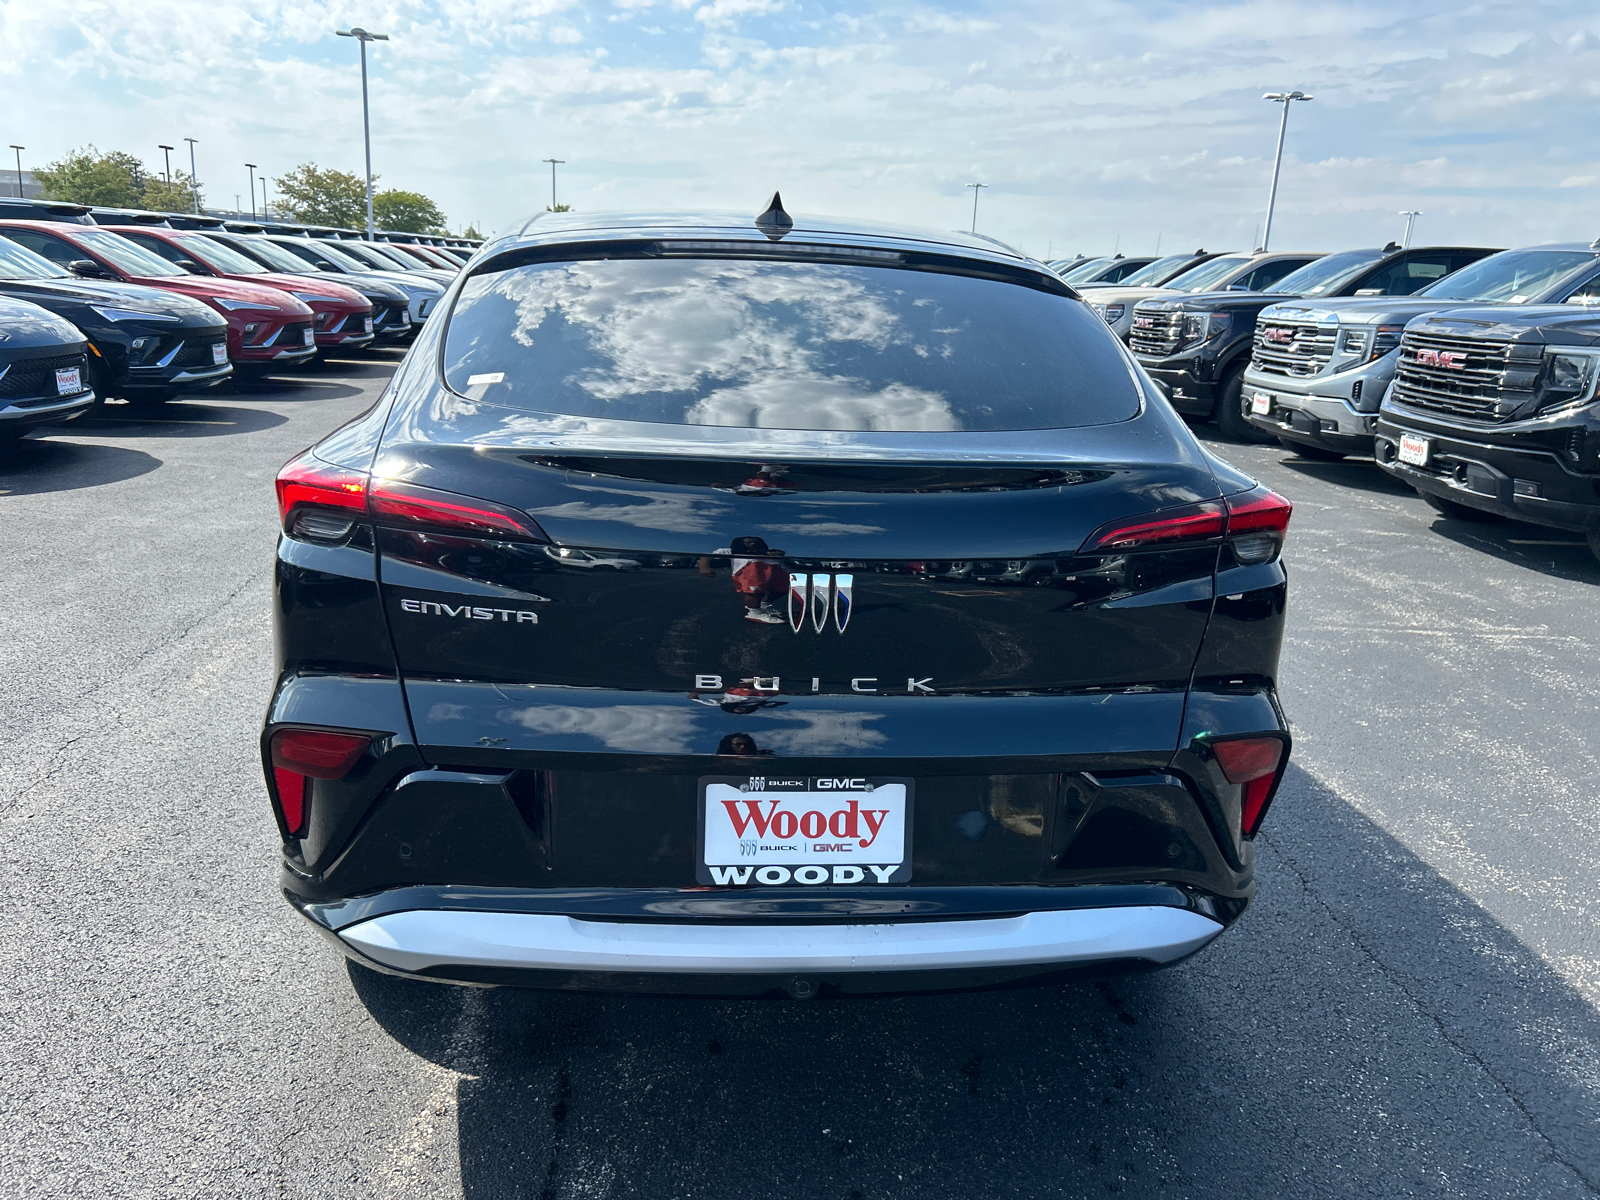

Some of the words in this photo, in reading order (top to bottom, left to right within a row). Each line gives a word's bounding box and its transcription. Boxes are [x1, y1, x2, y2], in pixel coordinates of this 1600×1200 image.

[1417, 349, 1468, 369] GMC
[1403, 439, 1424, 456] Woody
[400, 599, 539, 625] ENVISTA
[695, 674, 935, 692] BUICK
[816, 778, 866, 789] GMC
[720, 800, 890, 848] Woody
[813, 843, 853, 853] GMC
[708, 865, 900, 885] WOODY
